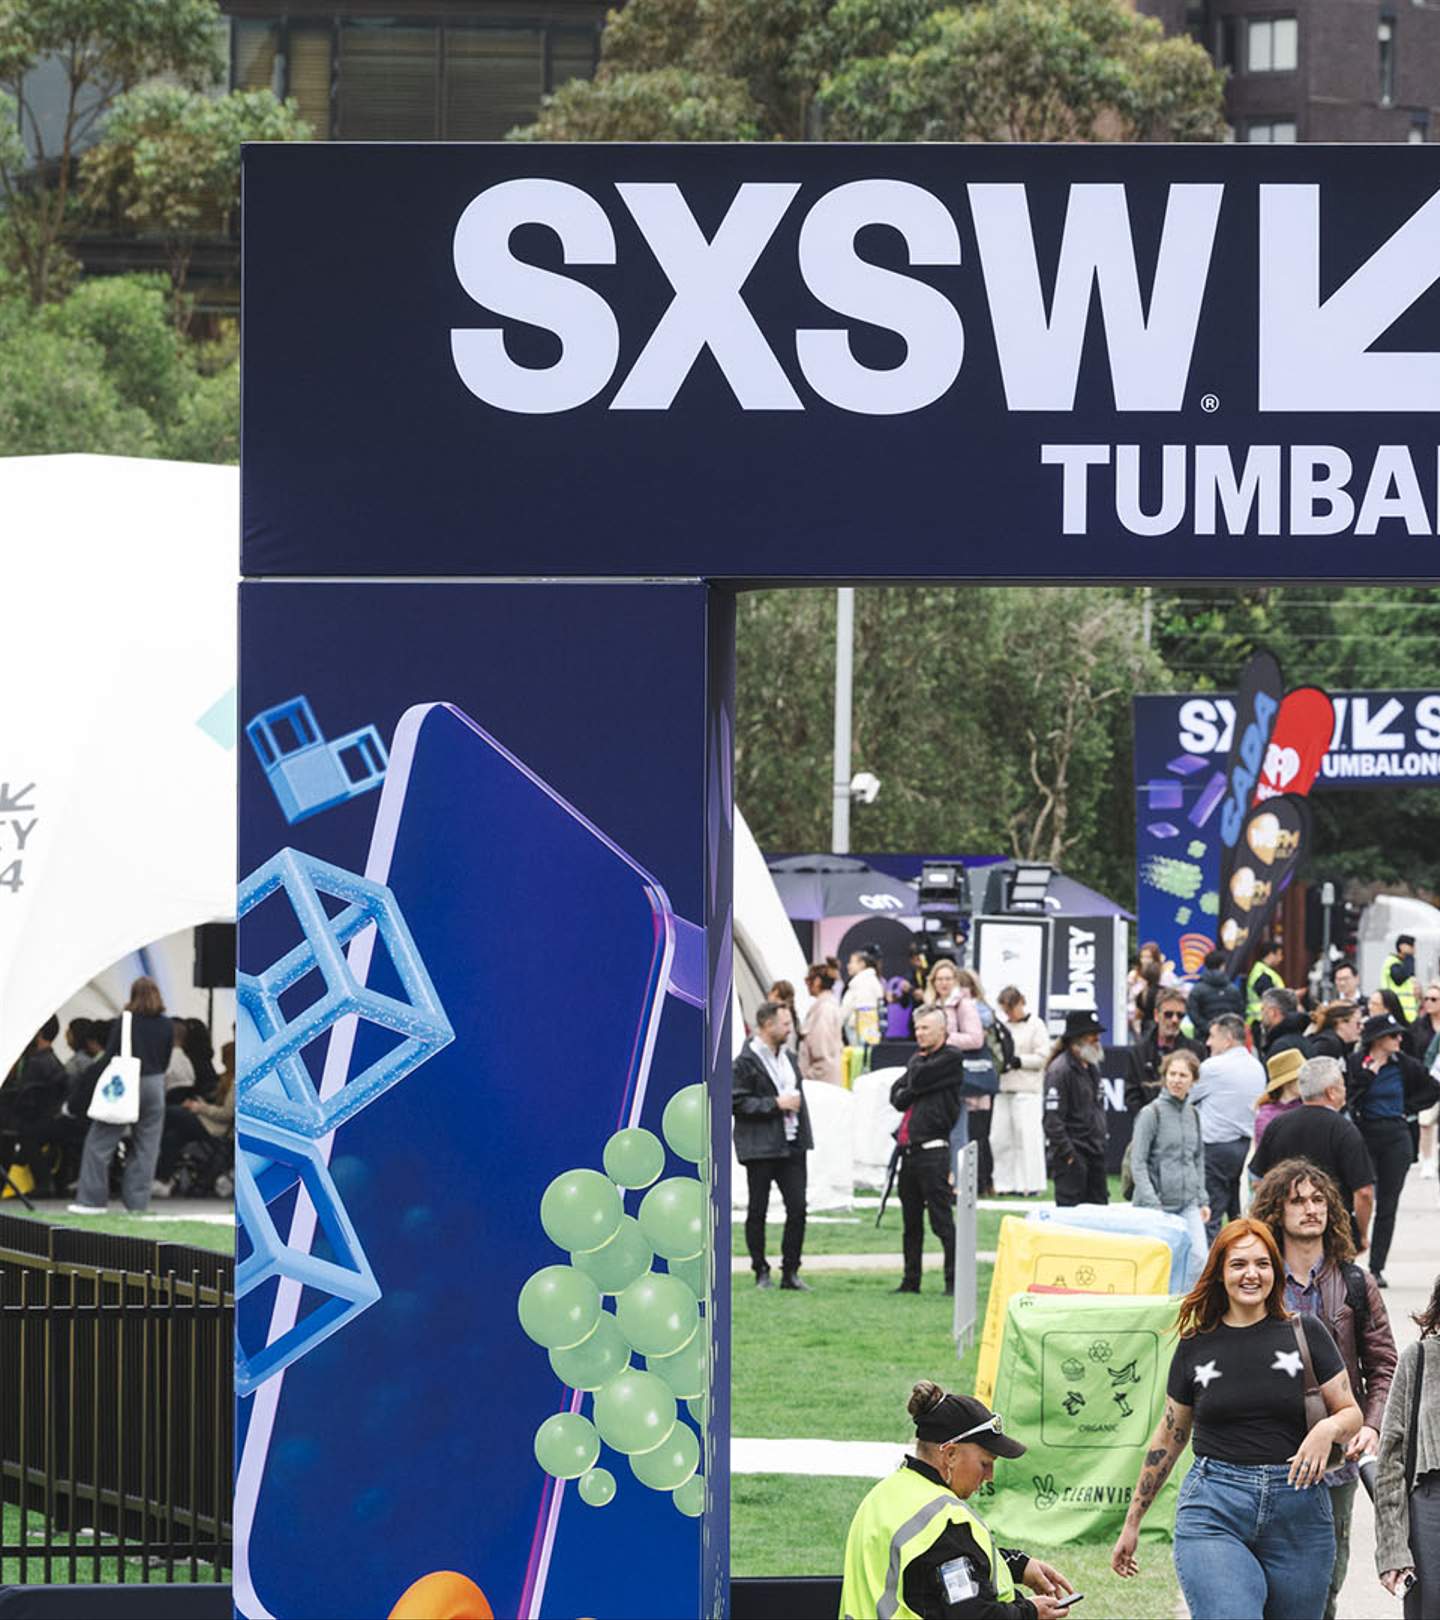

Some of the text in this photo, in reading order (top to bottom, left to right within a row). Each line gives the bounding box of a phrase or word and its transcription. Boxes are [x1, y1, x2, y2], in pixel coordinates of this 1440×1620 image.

[451, 179, 1224, 414] SXSW
[0, 818, 39, 850] Y
[1068, 925, 1096, 1001] DNEY
[1062, 1486, 1134, 1505] CLEANVIB
